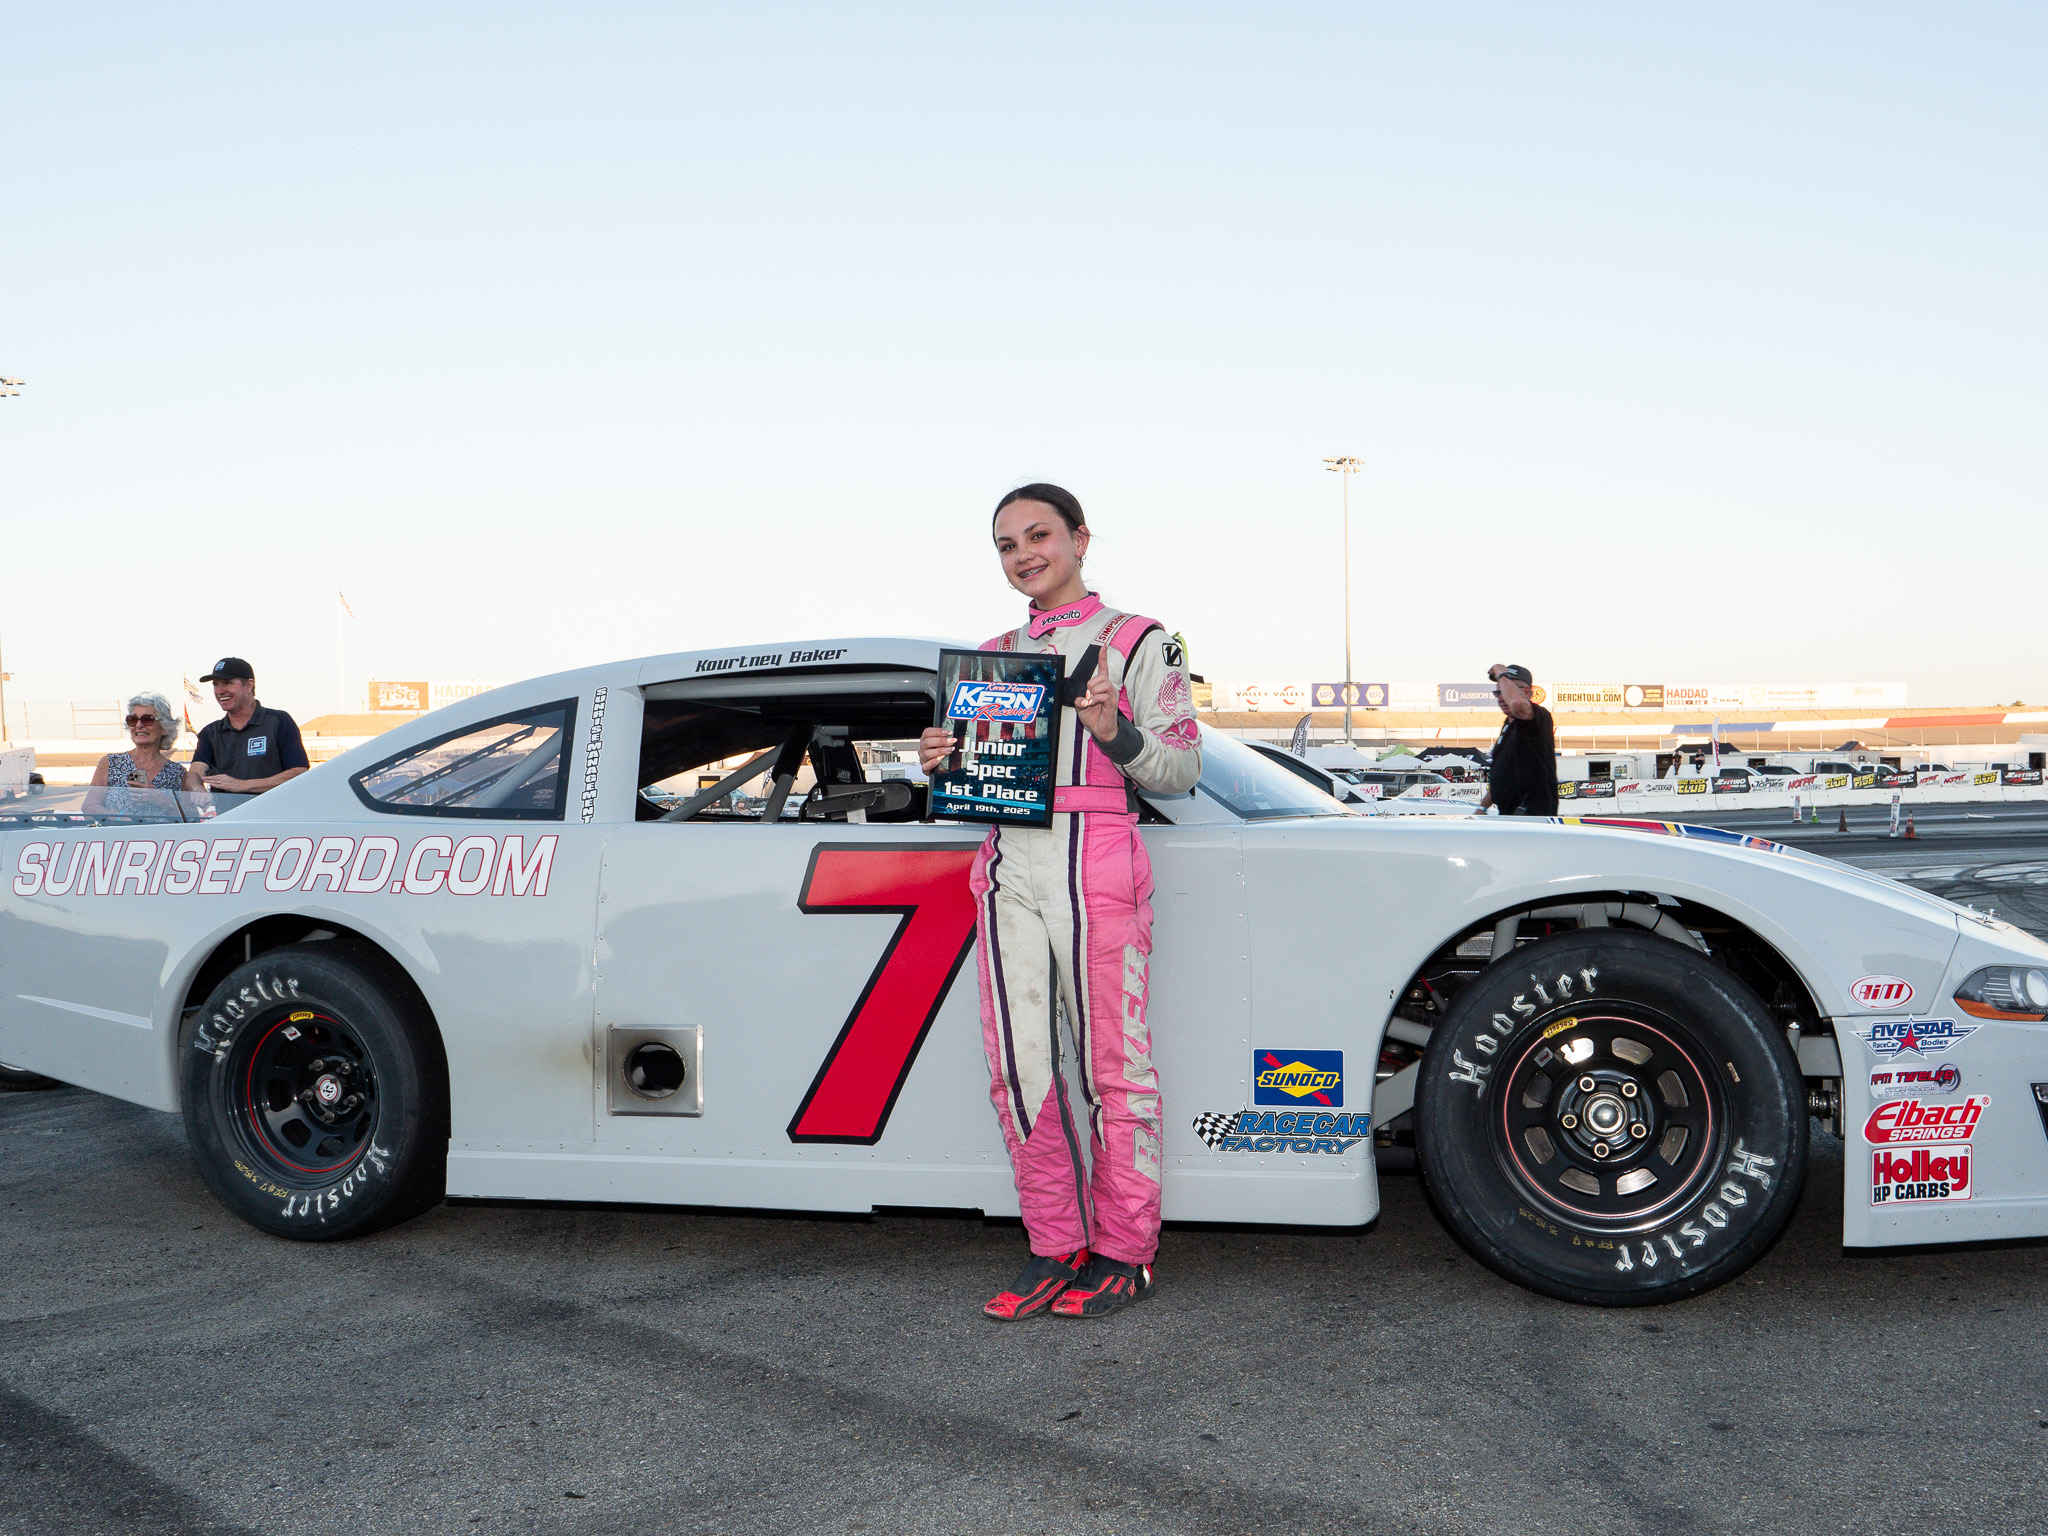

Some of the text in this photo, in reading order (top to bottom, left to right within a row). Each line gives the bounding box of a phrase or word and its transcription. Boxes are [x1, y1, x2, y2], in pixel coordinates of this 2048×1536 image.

[1098, 613, 1128, 642] SIMPSON
[695, 649, 848, 673] Kourtney Baker
[955, 685, 1037, 709] KERN
[985, 682, 1006, 693] Kevin
[1557, 693, 1622, 703] BERCHTOLD.COM
[1666, 688, 1708, 699] HADDAD
[971, 703, 1035, 723] Raceway
[959, 737, 1027, 757] Junior
[966, 760, 1016, 780] Spec
[944, 781, 1038, 802] 1st Place
[1678, 784, 1706, 793] CLUB
[946, 802, 1031, 815] April 19th, 2025
[13, 835, 559, 897] SUNRISEFORD.COM
[786, 842, 984, 1146] 7
[194, 974, 299, 1063] Hoosier
[1449, 967, 1598, 1099] Hoosier
[1872, 1021, 1954, 1039] FIVE STAR
[1123, 944, 1162, 1185] BAKER
[1260, 1072, 1336, 1087] SUNOCO
[1234, 1111, 1371, 1137] RACECAR
[1866, 1097, 1983, 1130] Eibach
[1889, 1126, 1967, 1141] SPRINGS
[1219, 1136, 1364, 1155] FACTORY
[281, 1138, 389, 1224] Hoosier
[1874, 1149, 1969, 1192] Holley
[1873, 1181, 1950, 1203] HP CARBS
[1615, 1137, 1776, 1272] Hoosier
